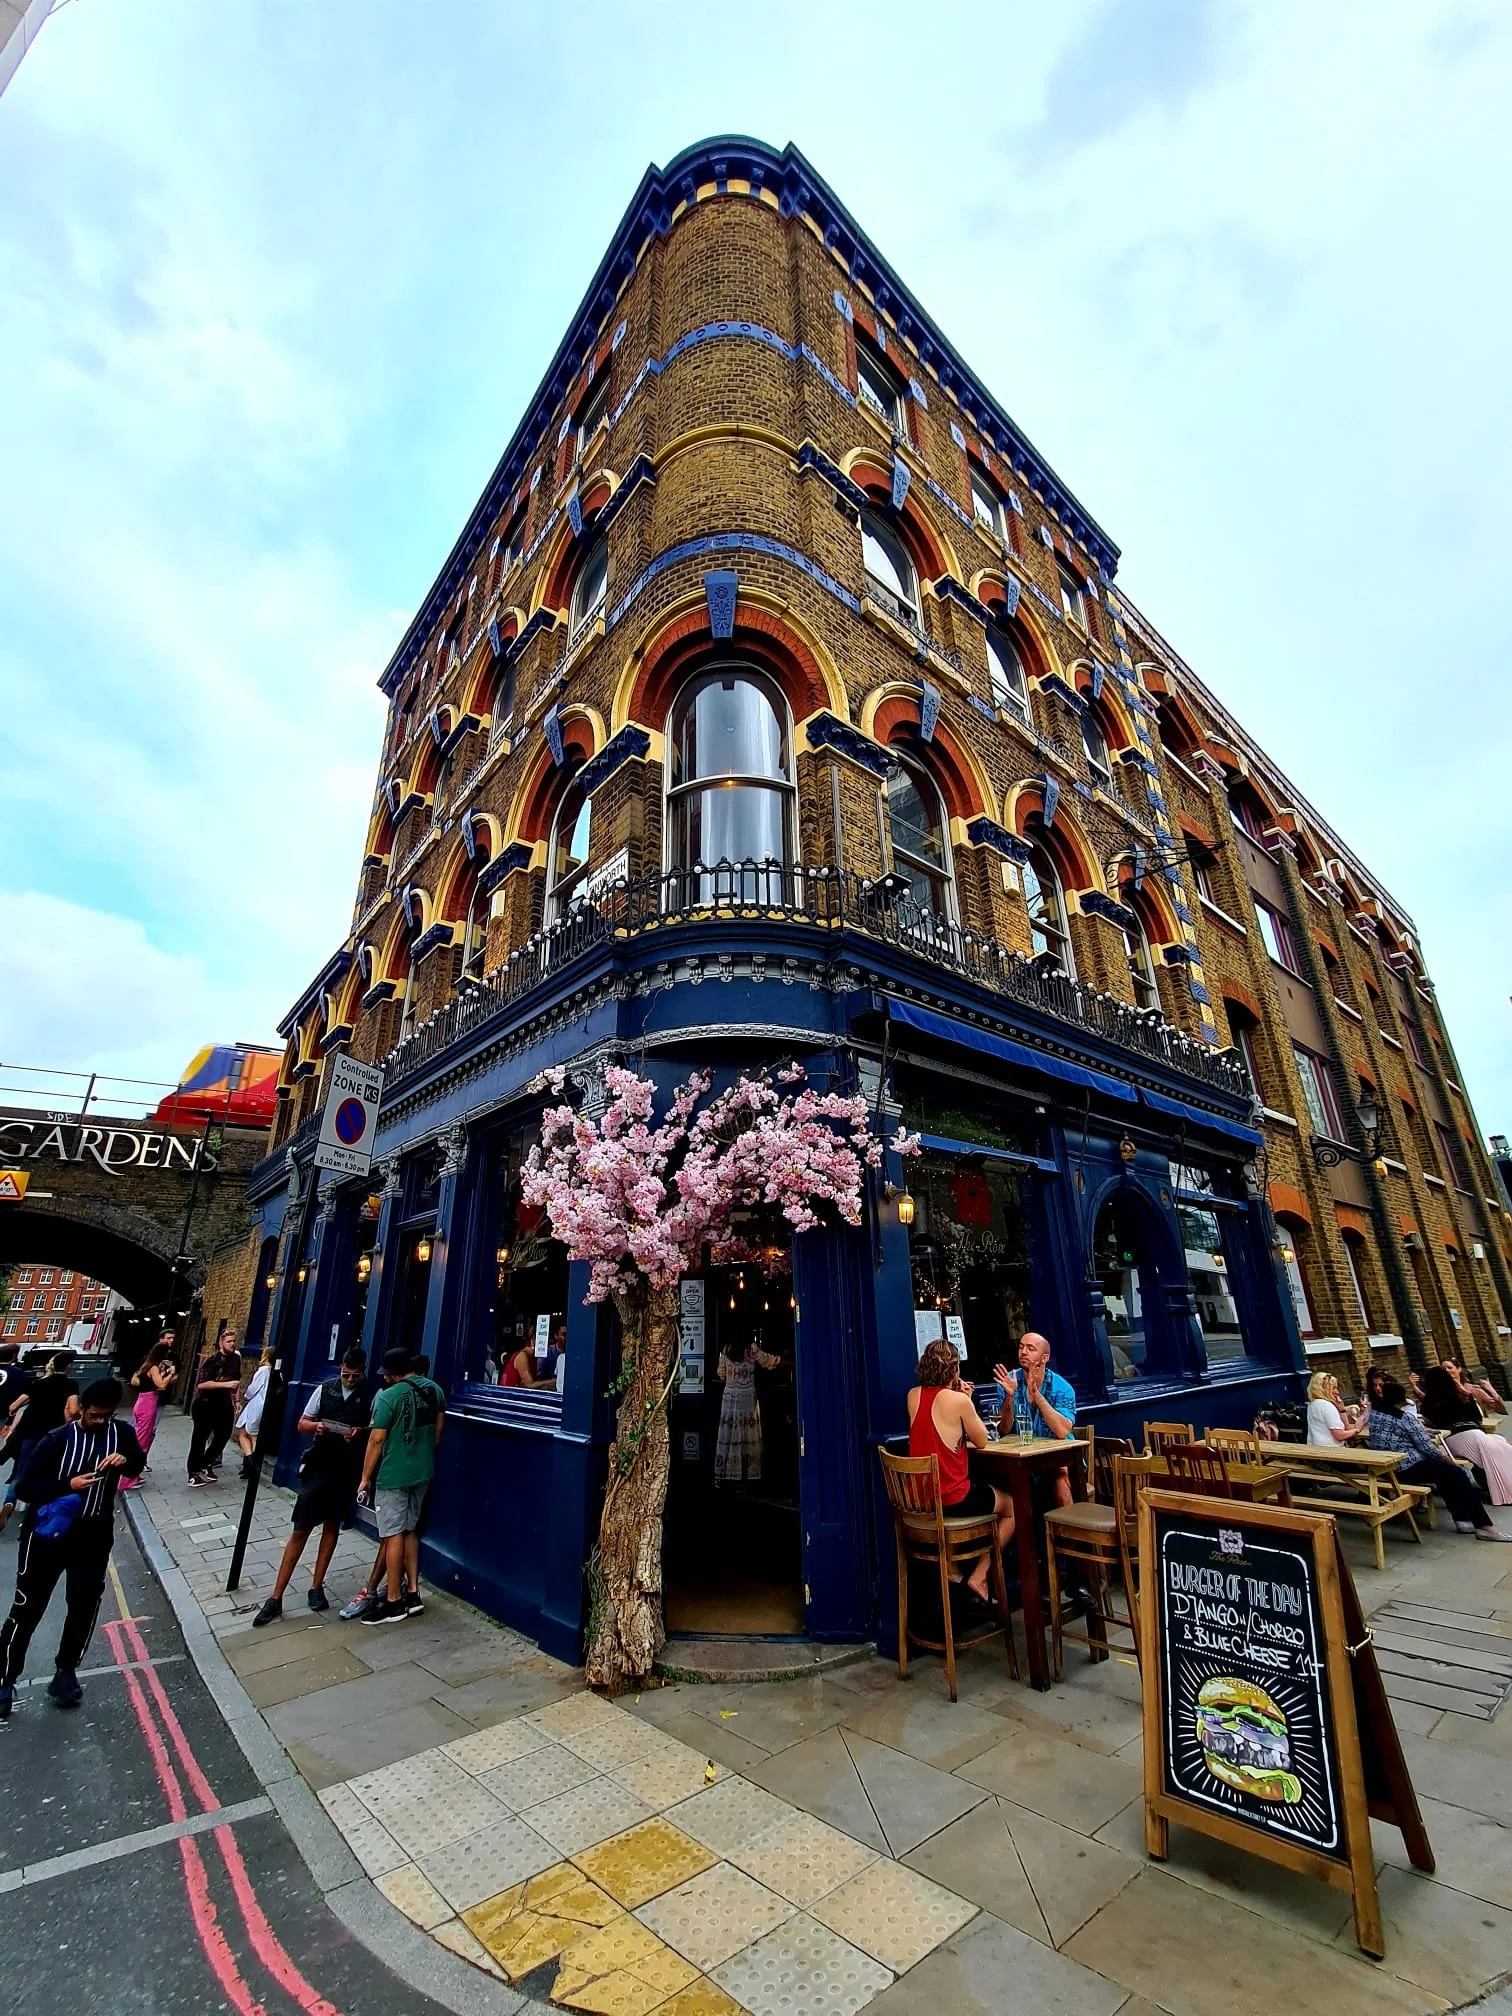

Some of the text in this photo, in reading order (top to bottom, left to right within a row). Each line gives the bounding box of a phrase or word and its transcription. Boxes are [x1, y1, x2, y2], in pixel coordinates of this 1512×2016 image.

[341, 1060, 379, 1083] Controlled
[333, 1075, 379, 1103] ZONE KS
[47, 1111, 73, 1123] SIDE
[0, 1122, 220, 1176] GARDENS
[1209, 1551, 1226, 1562] The
[1170, 1562, 1303, 1615] BURGER OF THE DAY
[1183, 1624, 1193, 1640] &
